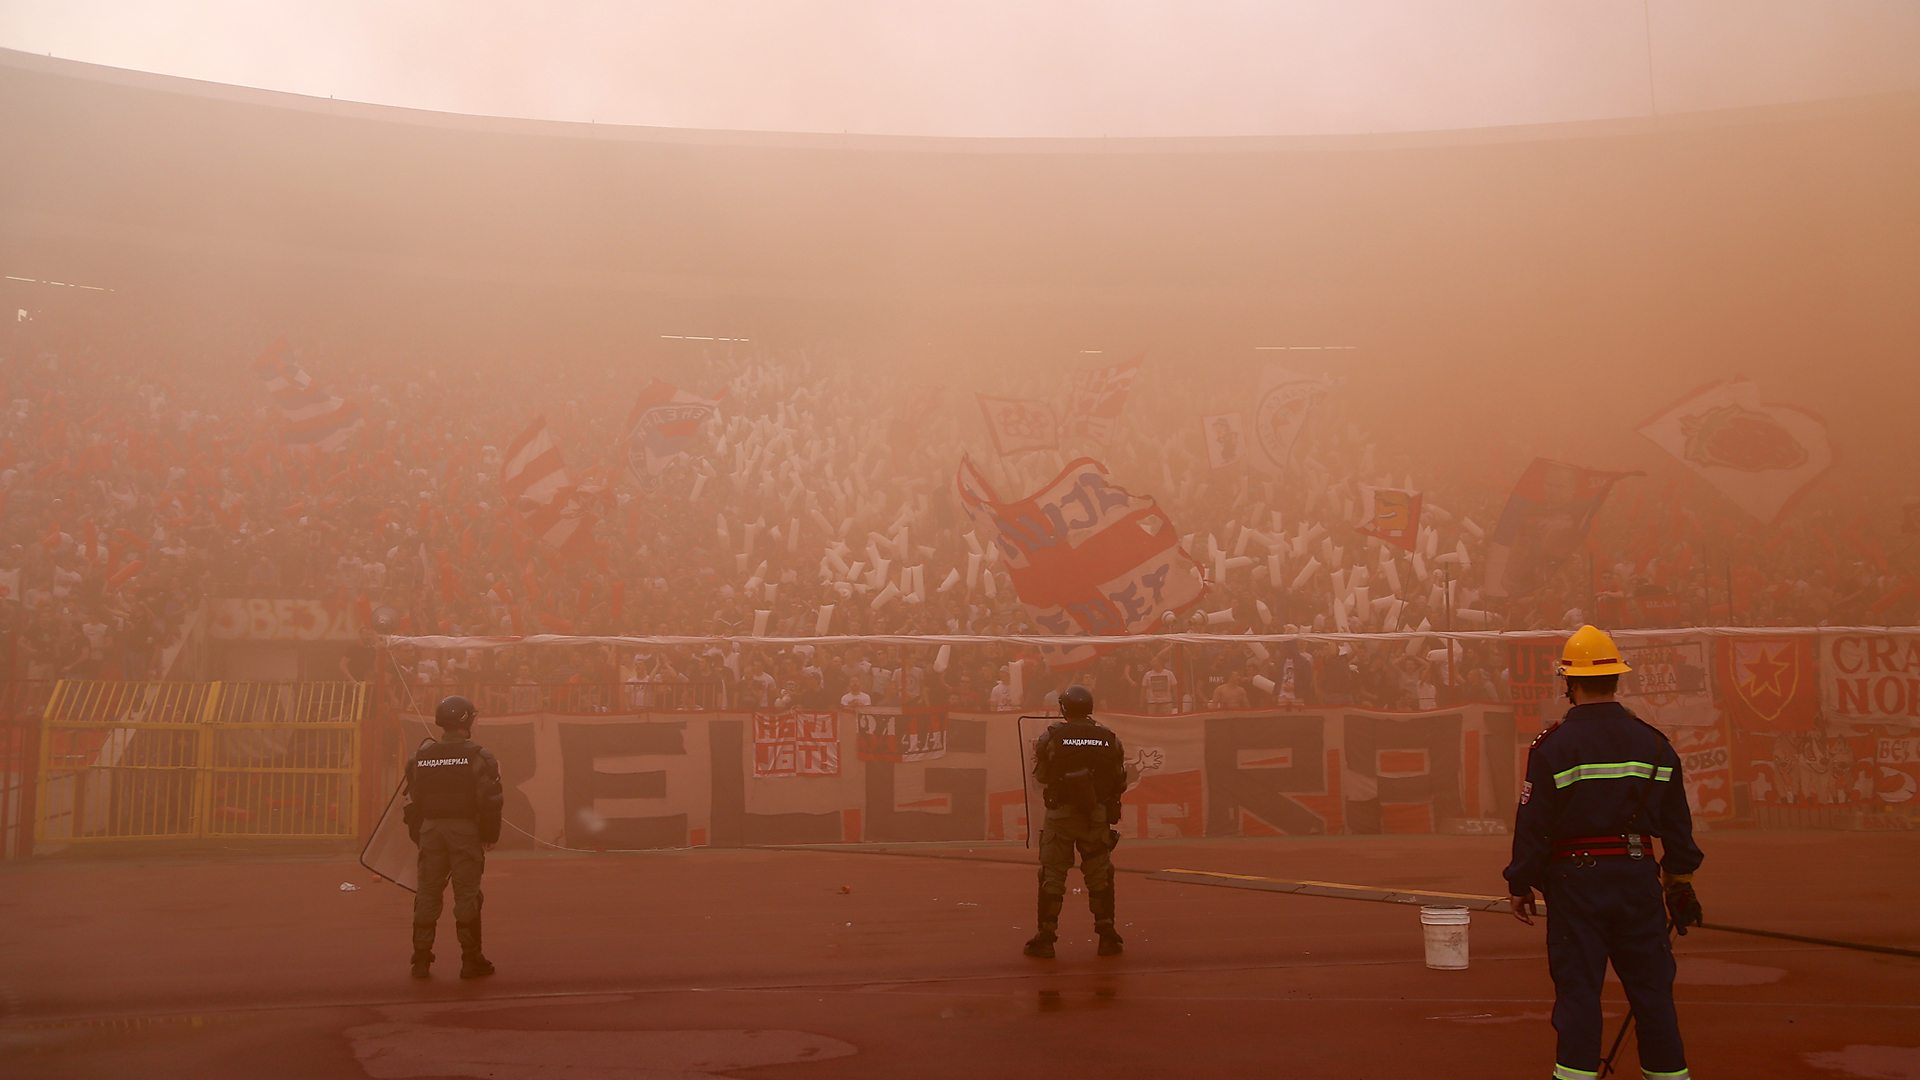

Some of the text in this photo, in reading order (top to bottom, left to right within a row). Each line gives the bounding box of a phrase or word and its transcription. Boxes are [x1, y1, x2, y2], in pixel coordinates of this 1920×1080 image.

[209, 598, 362, 640] ЗВЕЗД
[1062, 738, 1109, 747] ЖАНДАРМЕРИА
[417, 758, 468, 767] ЖАНДАРМЕРИЈА
[1685, 749, 1727, 770] ОВО
